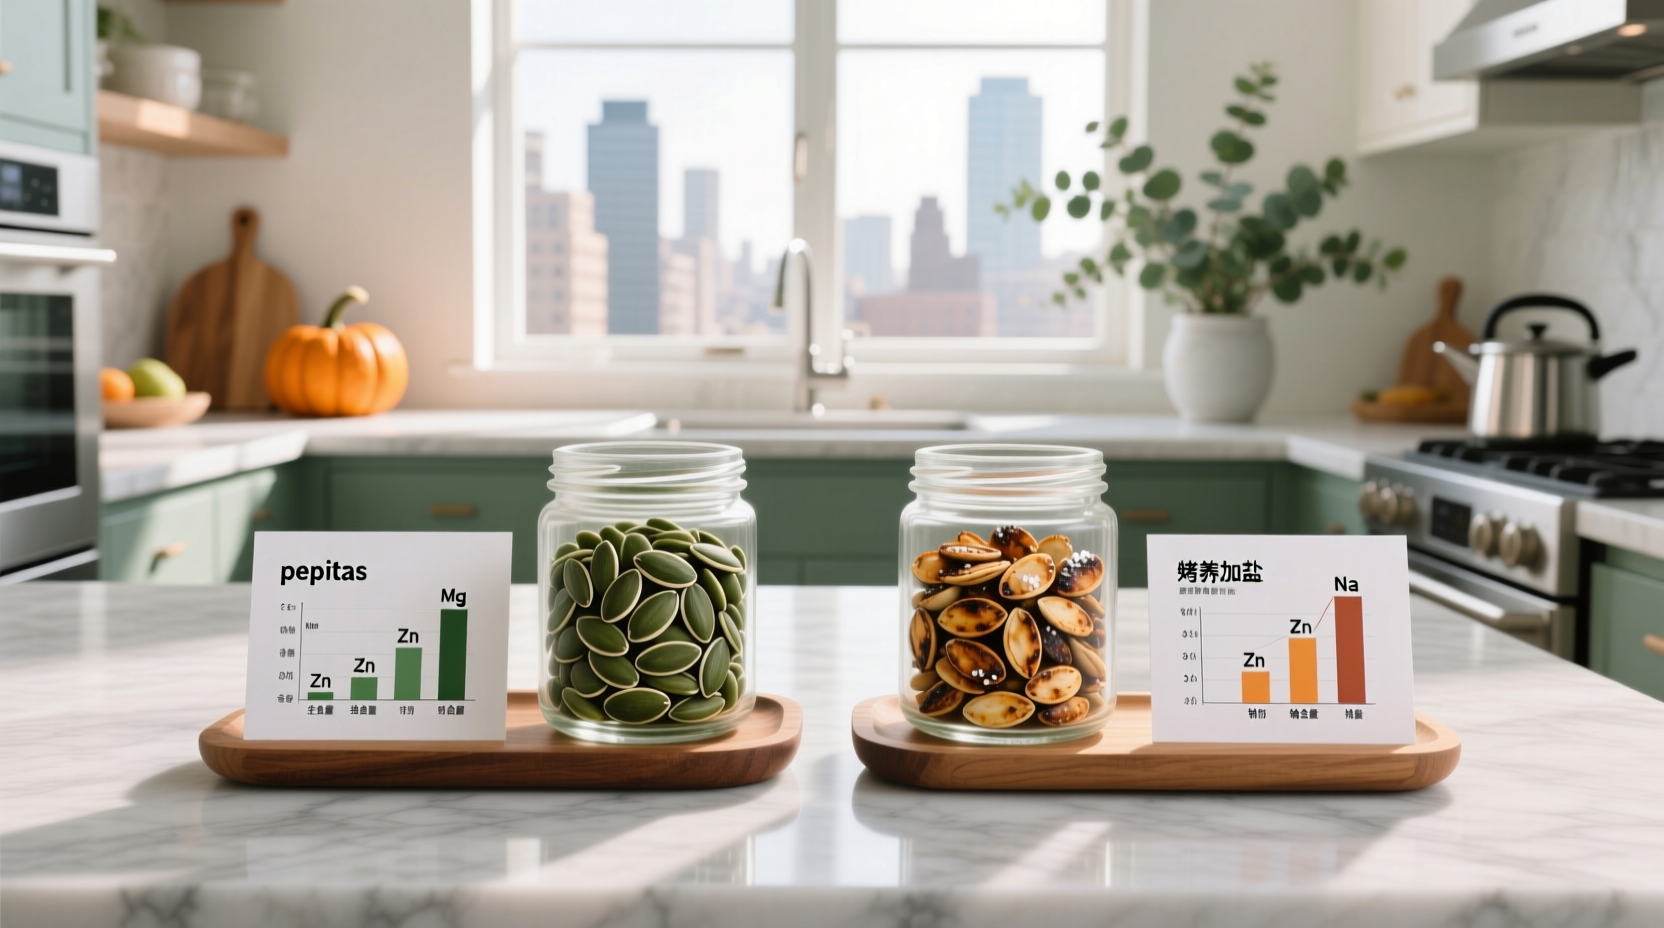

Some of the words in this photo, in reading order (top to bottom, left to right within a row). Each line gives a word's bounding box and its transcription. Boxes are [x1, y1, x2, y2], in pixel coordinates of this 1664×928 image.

[281, 560, 367, 585] pepitas
[1334, 576, 1359, 592] Na
[441, 589, 467, 608] Mg
[1289, 619, 1312, 634] Zn
[397, 628, 419, 643] Zn
[353, 658, 375, 673] Zn
[1243, 652, 1265, 668] Zn
[310, 673, 331, 688] Zn
